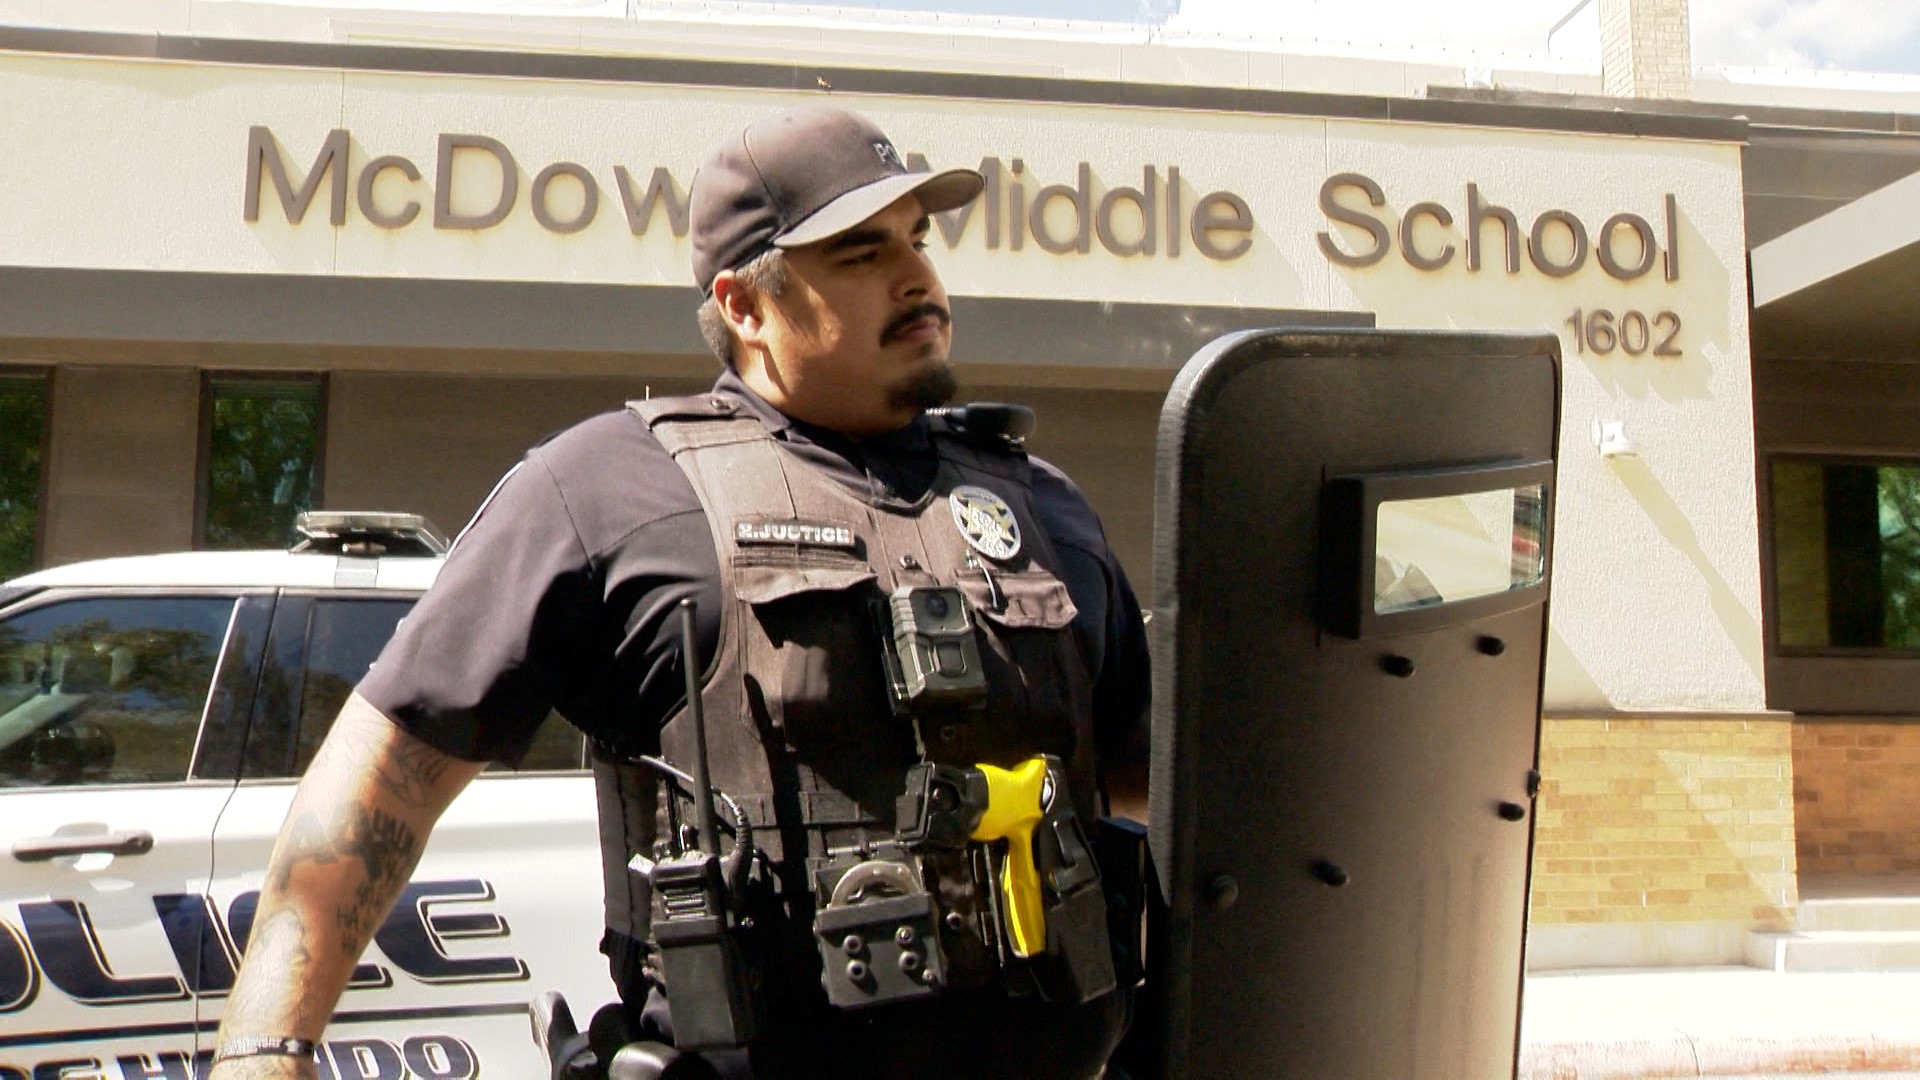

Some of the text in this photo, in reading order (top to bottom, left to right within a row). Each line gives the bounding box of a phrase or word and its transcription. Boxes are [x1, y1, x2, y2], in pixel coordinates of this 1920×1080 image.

[244, 125, 699, 237] McDow
[1317, 172, 1680, 282] School
[1564, 307, 1683, 356] 1602
